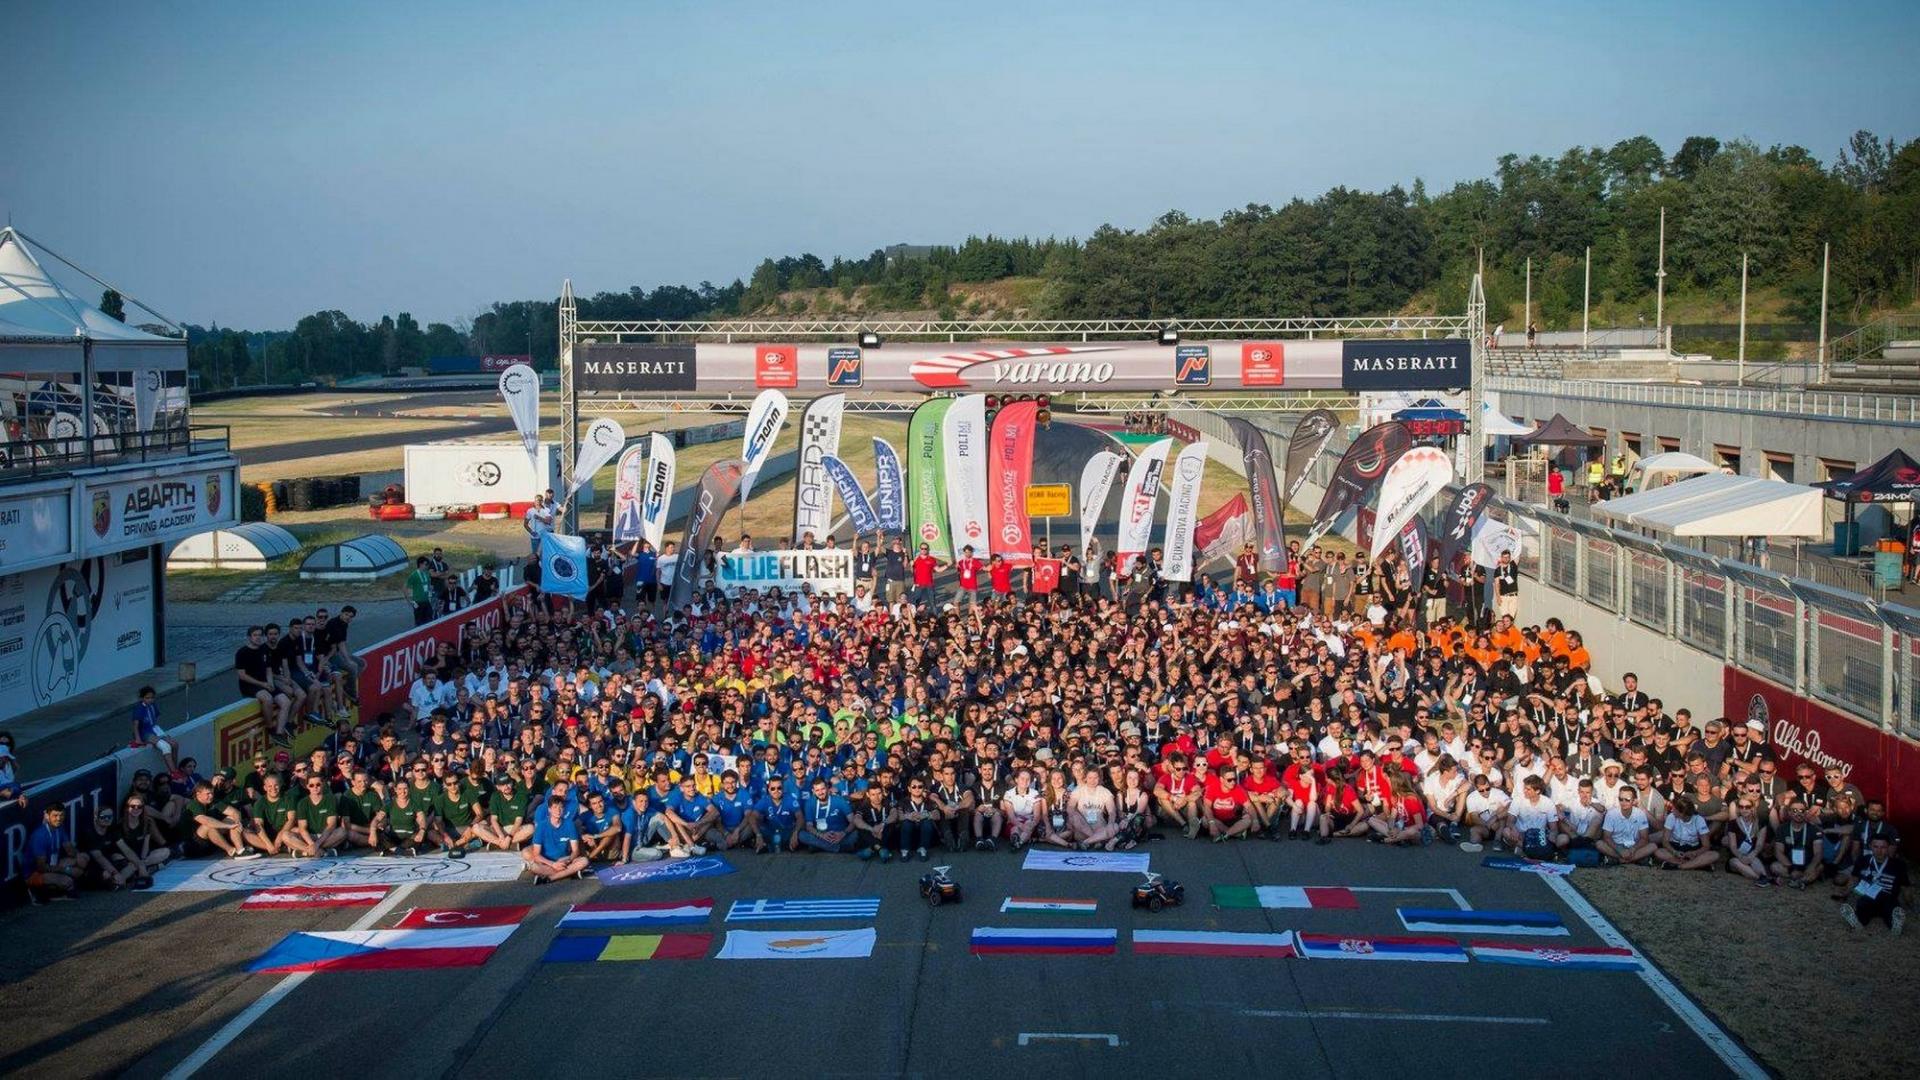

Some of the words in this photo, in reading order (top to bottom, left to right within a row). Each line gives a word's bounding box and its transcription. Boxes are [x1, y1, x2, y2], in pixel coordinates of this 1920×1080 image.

[584, 361, 685, 375] MASERATI
[993, 361, 1115, 384] varano
[1353, 357, 1457, 371] MASERATI
[124, 482, 196, 515] ABARTH
[799, 446, 824, 529] HARD
[831, 465, 867, 527] UNIPR
[879, 454, 893, 520] UNIPR
[1181, 482, 1194, 511] RACING
[1873, 492, 1911, 500] 24MX
[124, 520, 157, 536] DRIVING
[159, 512, 196, 530] ACADEMY
[720, 555, 849, 580] BLUEFLASH
[381, 636, 436, 695] DENSO
[1774, 719, 1804, 761] Alfa
[4, 787, 103, 882] RTI
